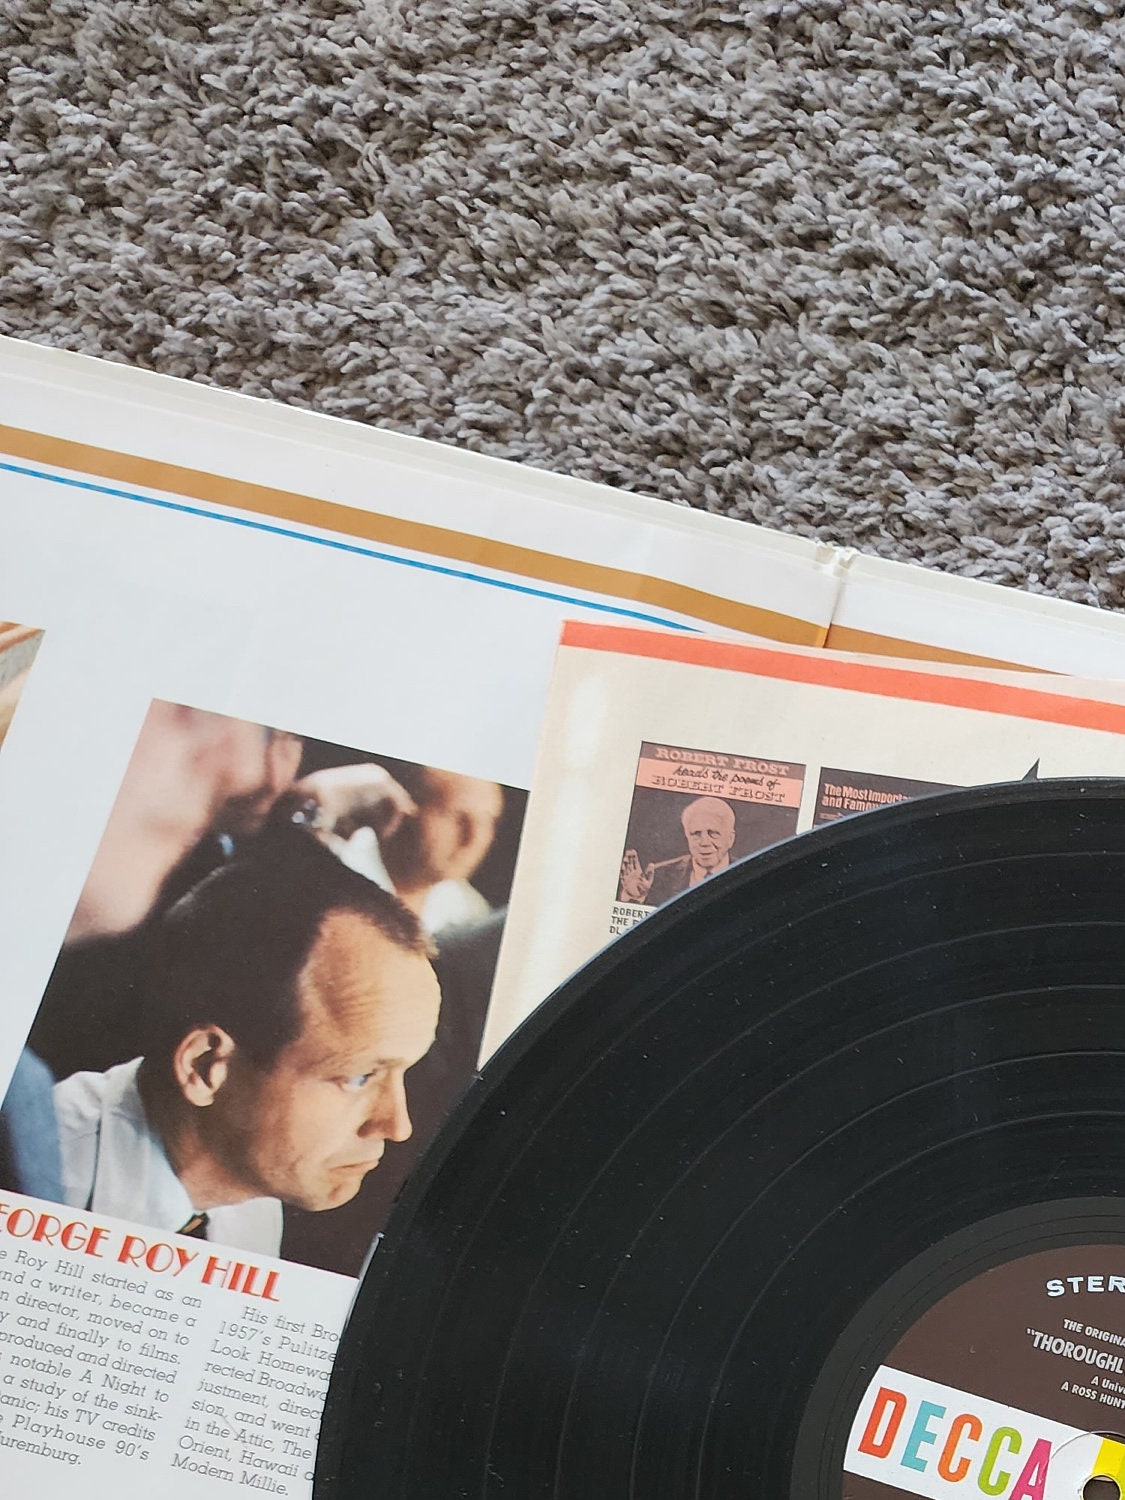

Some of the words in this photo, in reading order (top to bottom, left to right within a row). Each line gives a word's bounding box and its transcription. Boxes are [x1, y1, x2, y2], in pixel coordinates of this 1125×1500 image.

[656, 748, 729, 768] ROBERT
[734, 759, 789, 775] FROST
[652, 775, 724, 794] ROBERT
[729, 786, 786, 803] FROST
[822, 795, 841, 807] and
[824, 784, 841, 795] The
[843, 786, 867, 800] Most
[0, 1203, 112, 1258] ORGE
[117, 1235, 199, 1277] ROY
[201, 1256, 280, 1302] HILL
[15, 1250, 47, 1271] Roy
[55, 1260, 84, 1279] Hill
[91, 1272, 148, 1294] started
[16, 1292, 80, 1320] director,
[88, 1312, 143, 1334] moved
[49, 1282, 102, 1306] writer,
[110, 1295, 179, 1322] became
[242, 1306, 268, 1325] His
[274, 1316, 306, 1334] first
[17, 1316, 50, 1331] and
[56, 1322, 109, 1348] finally
[139, 1343, 181, 1365] films.
[219, 1321, 272, 1346] 1957's
[1063, 1318, 1083, 1334] THE
[77, 1352, 109, 1367] and
[112, 1358, 177, 1384] directed
[211, 1339, 251, 1361] Look
[10, 1354, 71, 1378] notable
[102, 1374, 146, 1397] Night
[204, 1361, 255, 1382] rected
[21, 1378, 66, 1400] study
[95, 1394, 118, 1410] the
[125, 1404, 163, 1422] sink-
[197, 1378, 270, 1408] justment,
[1072, 1384, 1098, 1401] ROSS
[44, 1401, 69, 1419] his
[76, 1409, 100, 1425] TV
[102, 1420, 156, 1441] credits
[192, 1399, 228, 1418] sion,
[235, 1411, 267, 1427] and
[272, 1419, 311, 1438] went
[0, 1431, 81, 1465] uremburg.
[12, 1414, 106, 1449] Playhouse
[115, 1440, 150, 1461] 90's
[206, 1421, 230, 1439] the
[234, 1428, 275, 1452] Attic,
[282, 1440, 312, 1459] The
[179, 1435, 232, 1461] Orient,
[239, 1450, 299, 1477] Hawaii
[171, 1453, 234, 1482] Modern
[239, 1471, 289, 1496] Millie.
